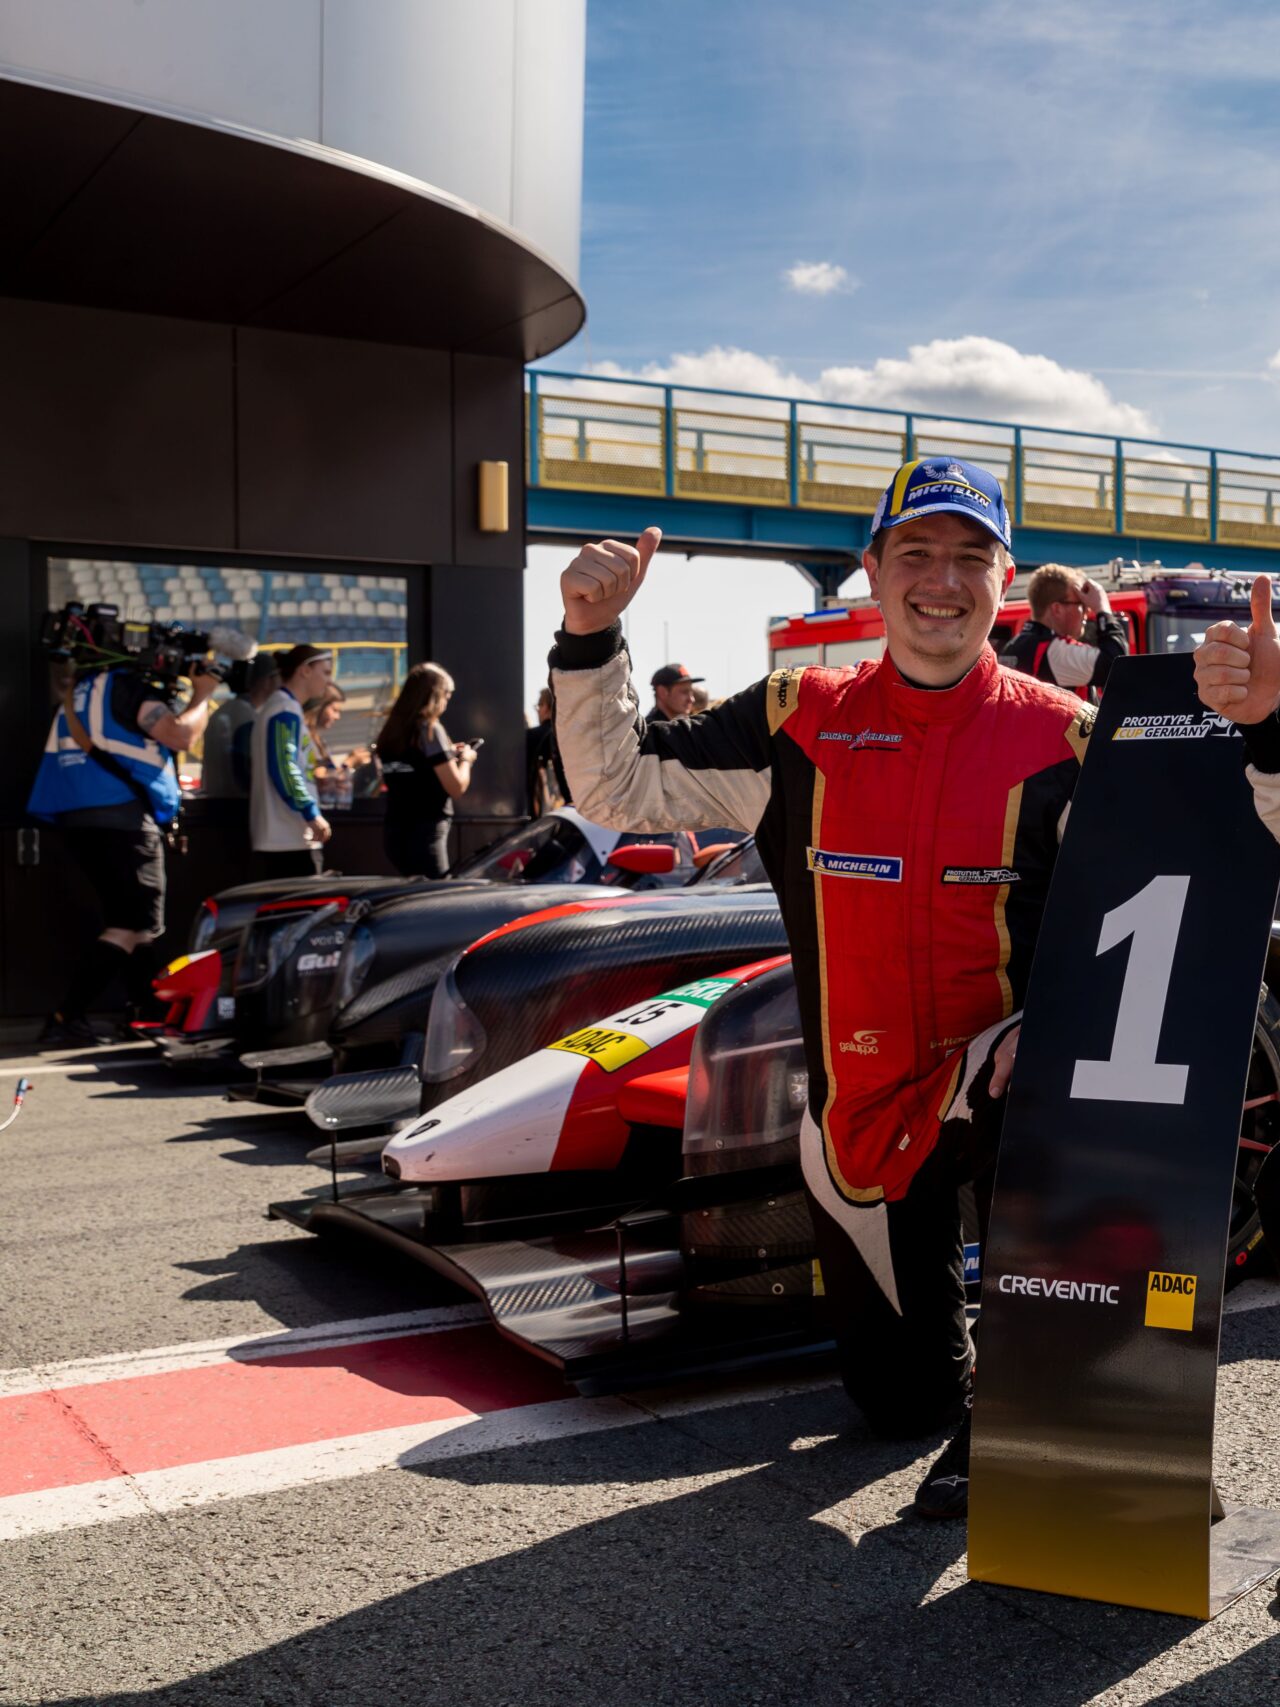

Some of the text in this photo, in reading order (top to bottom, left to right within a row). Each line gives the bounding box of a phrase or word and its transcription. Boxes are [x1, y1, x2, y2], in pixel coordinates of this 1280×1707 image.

[907, 483, 990, 509] MICHELIN
[1119, 725, 1209, 739] CUP GERMANY
[1121, 714, 1194, 727] PROTOTYPE
[827, 859, 892, 874] MICHELIN
[1069, 875, 1191, 1105] 1
[615, 1001, 683, 1026] 15
[562, 1029, 627, 1055] ADAC
[839, 1040, 879, 1056] galuppo
[999, 1274, 1120, 1305] CREVENTIC
[1150, 1274, 1195, 1295] ADAC
